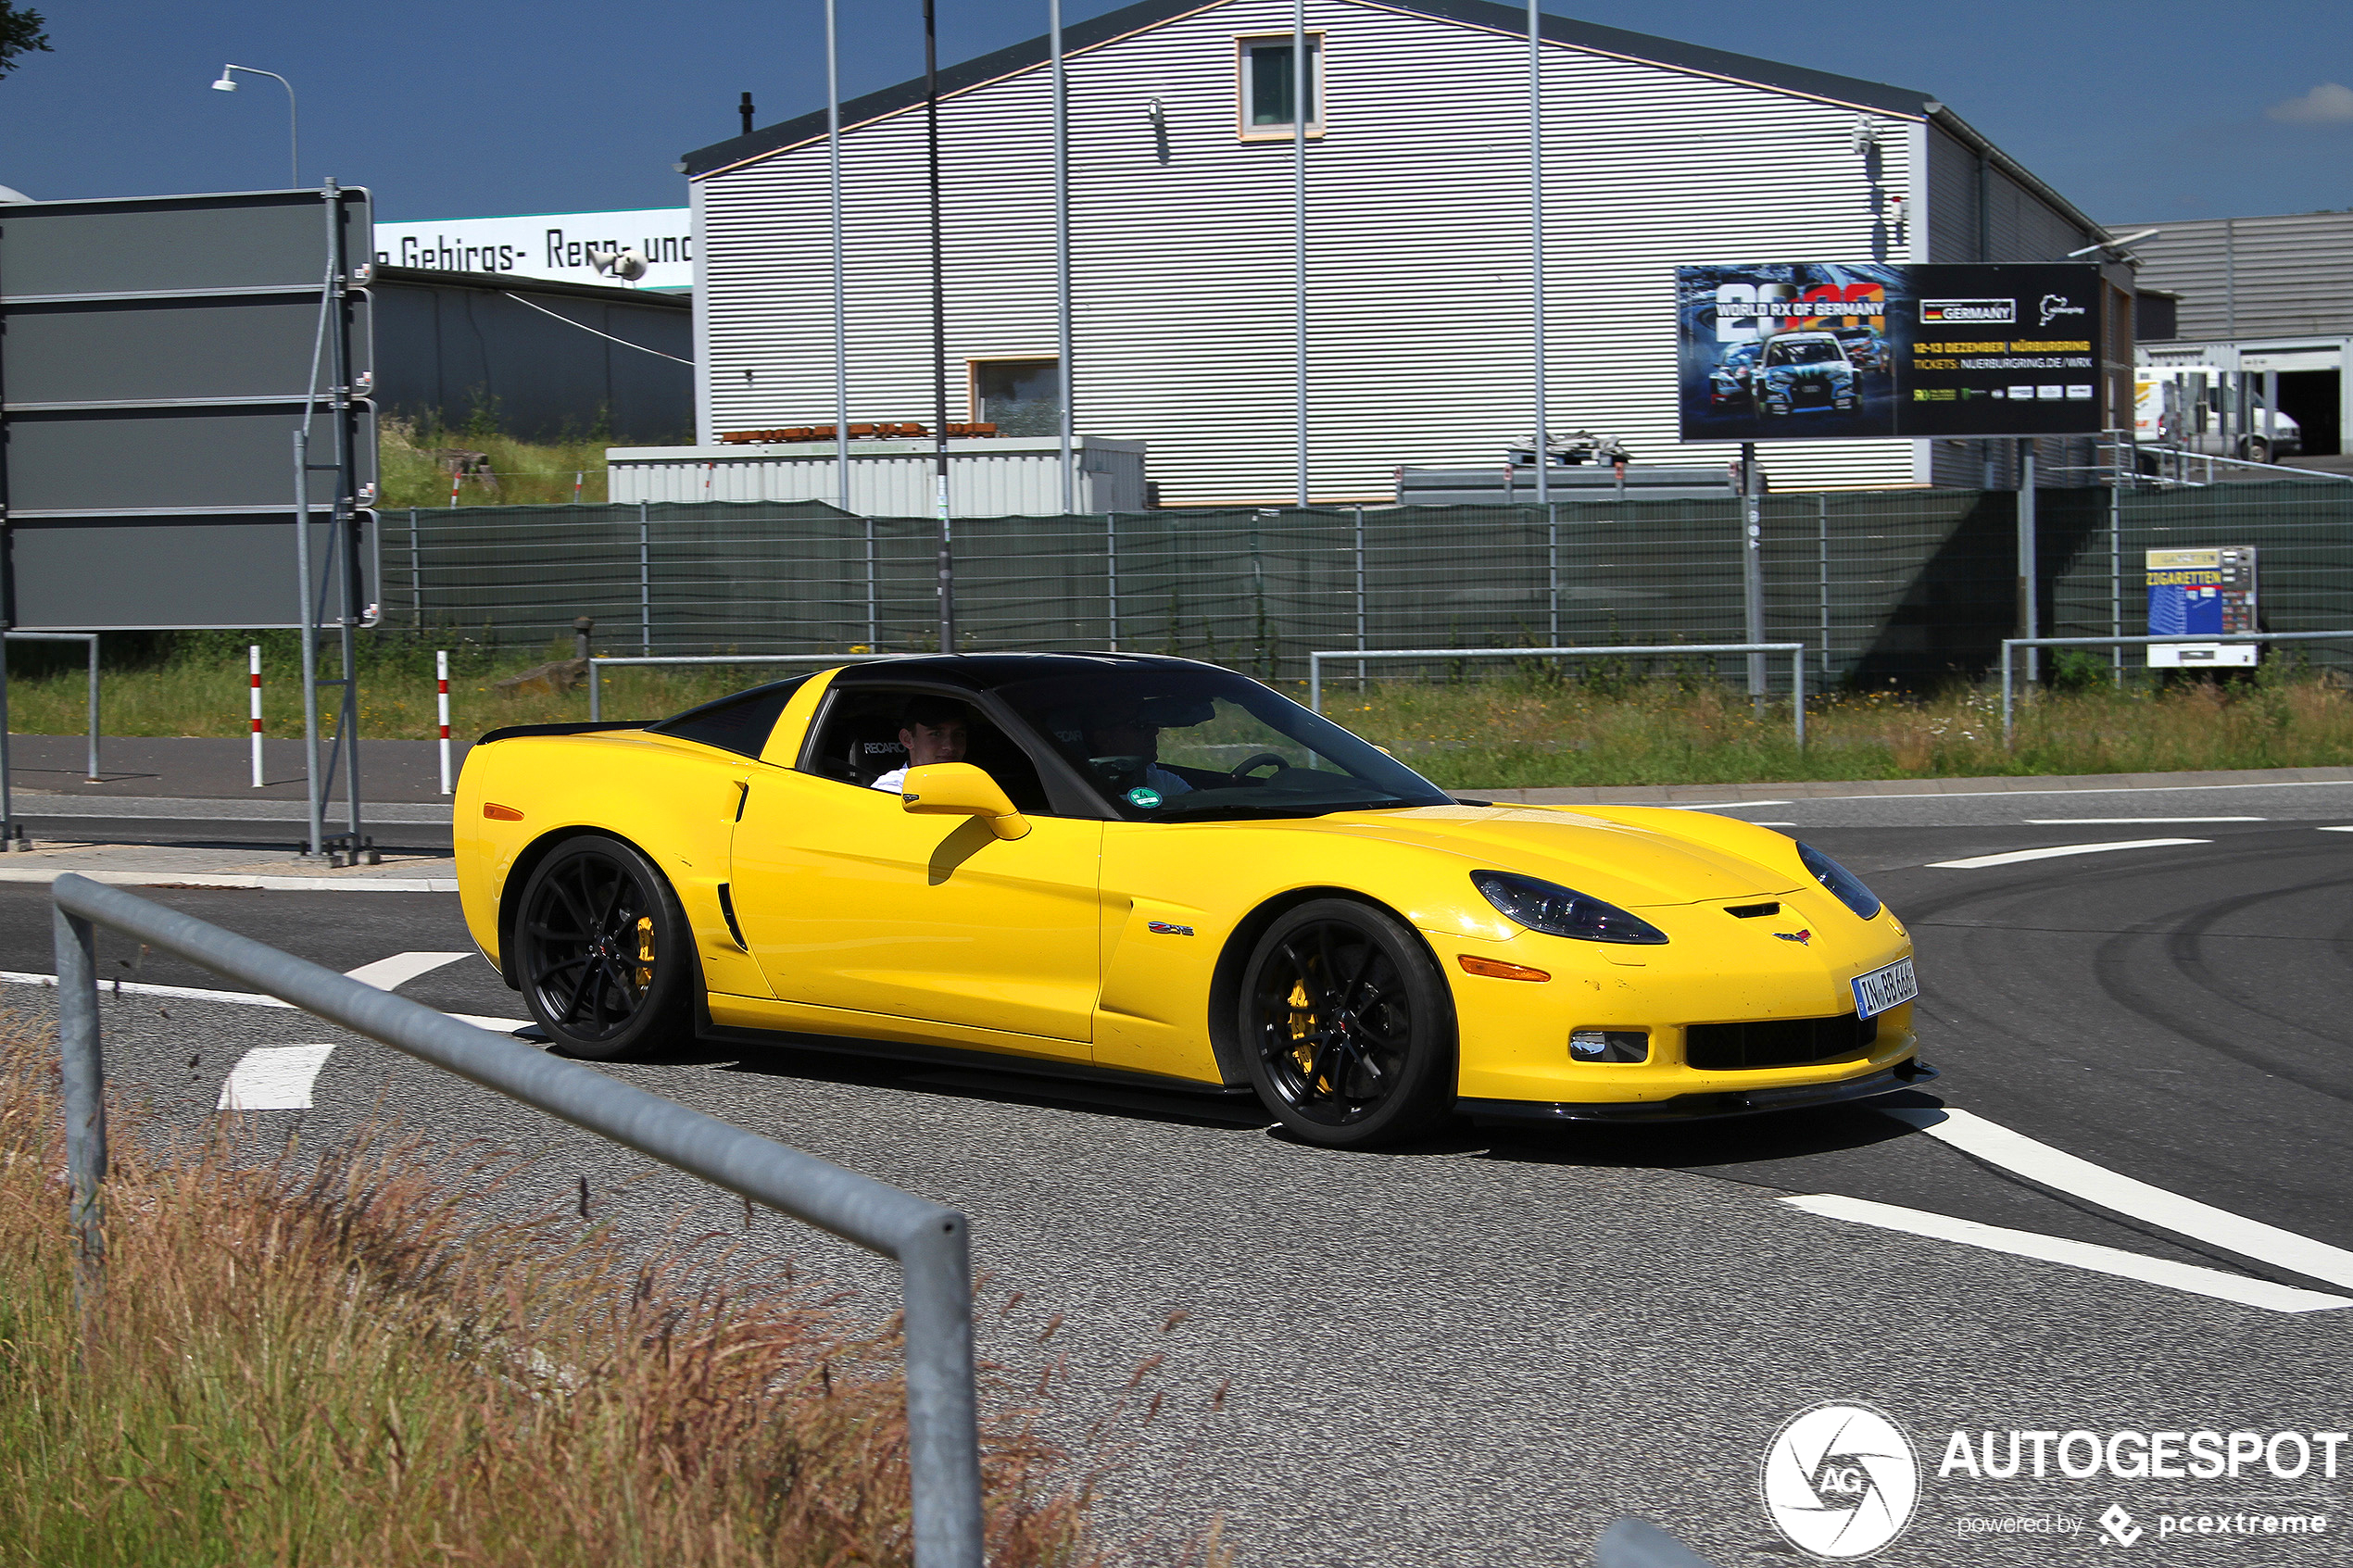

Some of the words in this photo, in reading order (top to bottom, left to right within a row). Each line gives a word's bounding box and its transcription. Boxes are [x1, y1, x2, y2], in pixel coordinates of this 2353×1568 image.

[1717, 304, 1768, 316] WORLD
[1770, 303, 1792, 316] RX
[1793, 303, 1813, 316] OF
[1814, 303, 1885, 316] GERMANY
[1943, 307, 2010, 320] GERMANY
[2146, 571, 2221, 585] ZIGARETTEN
[864, 742, 908, 754] RECARO
[1861, 977, 1881, 1011] IN
[1880, 972, 1897, 1003] BB
